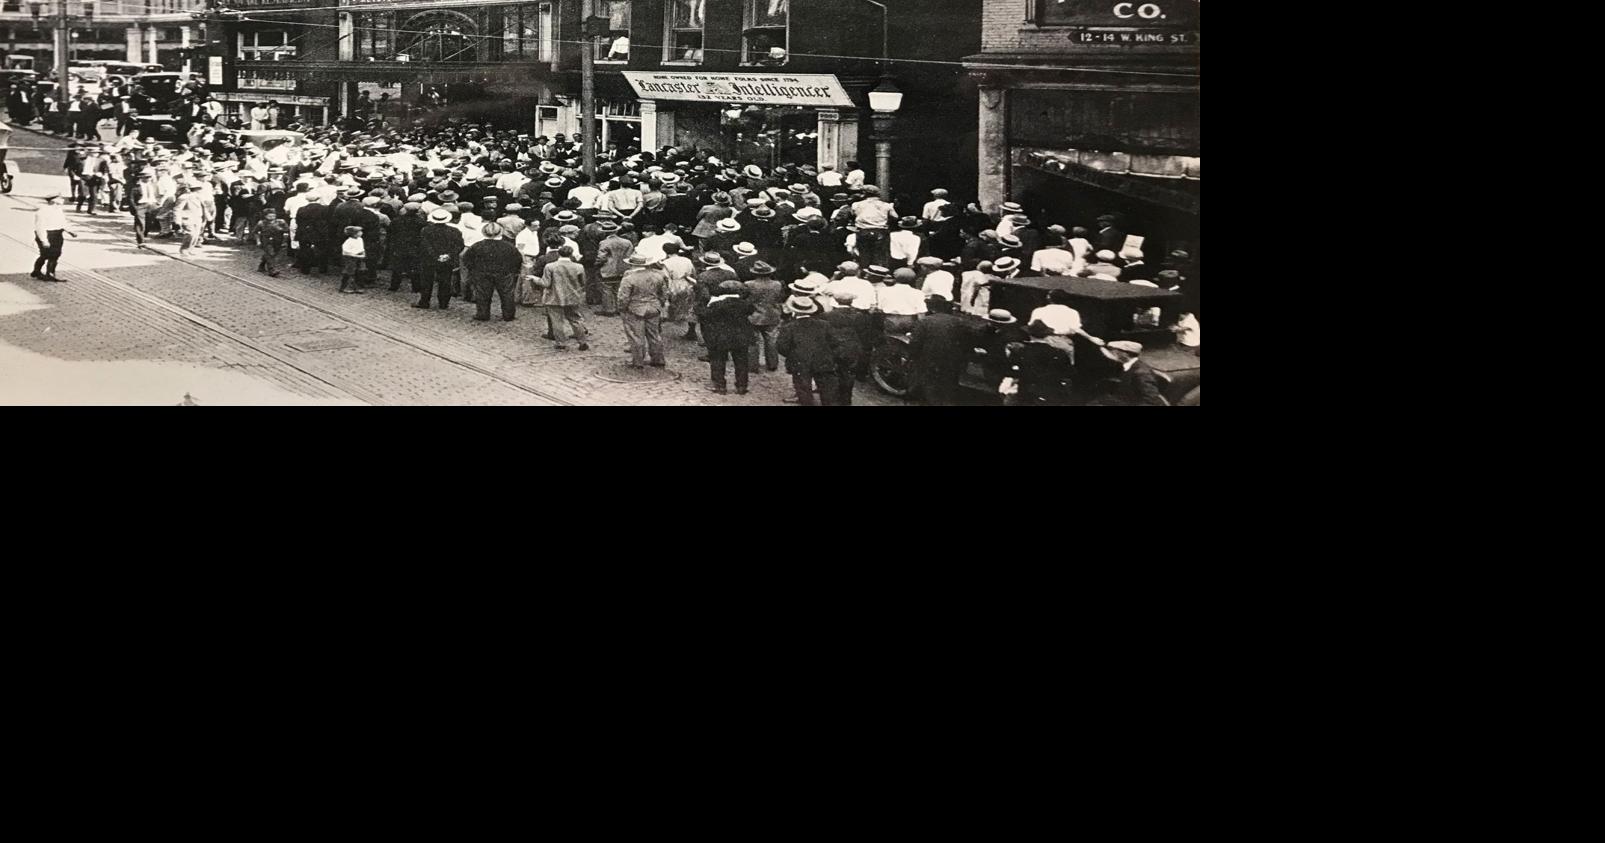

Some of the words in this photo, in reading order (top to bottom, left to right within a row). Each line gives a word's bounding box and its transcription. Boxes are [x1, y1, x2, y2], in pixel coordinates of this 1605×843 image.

[1112, 2, 1167, 19] CO.
[1135, 34, 1164, 42] KING
[635, 79, 701, 93] Lancaster
[728, 81, 831, 99] Intelligencer
